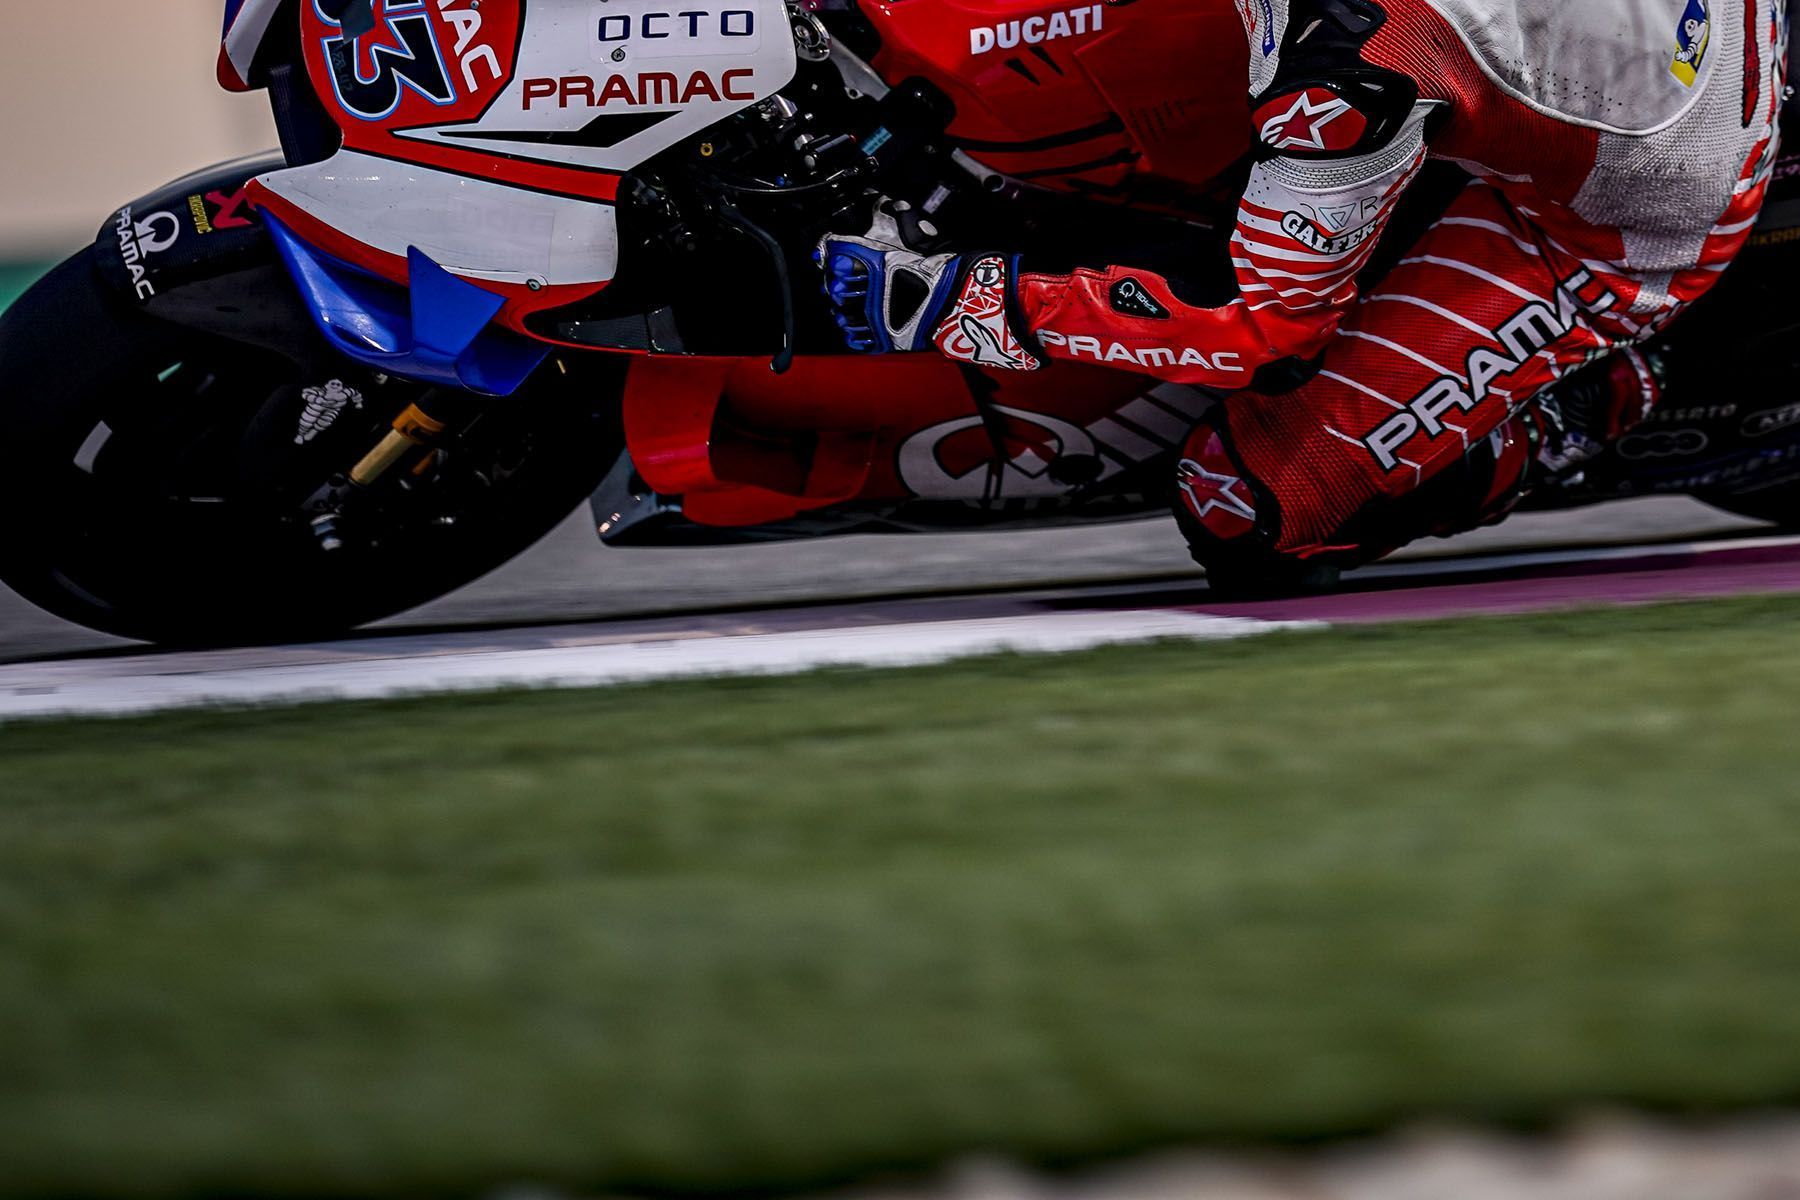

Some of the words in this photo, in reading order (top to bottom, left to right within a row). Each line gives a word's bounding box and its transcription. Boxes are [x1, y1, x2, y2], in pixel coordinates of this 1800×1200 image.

[598, 10, 755, 41] OCTO
[969, 3, 1102, 56] DUCATI
[521, 68, 756, 110] PRAMAC
[115, 206, 156, 300] PRAMAC
[1282, 212, 1376, 253] GALFER
[1037, 328, 1245, 372] PRAMAC
[1365, 268, 1617, 470] PRAMAC
